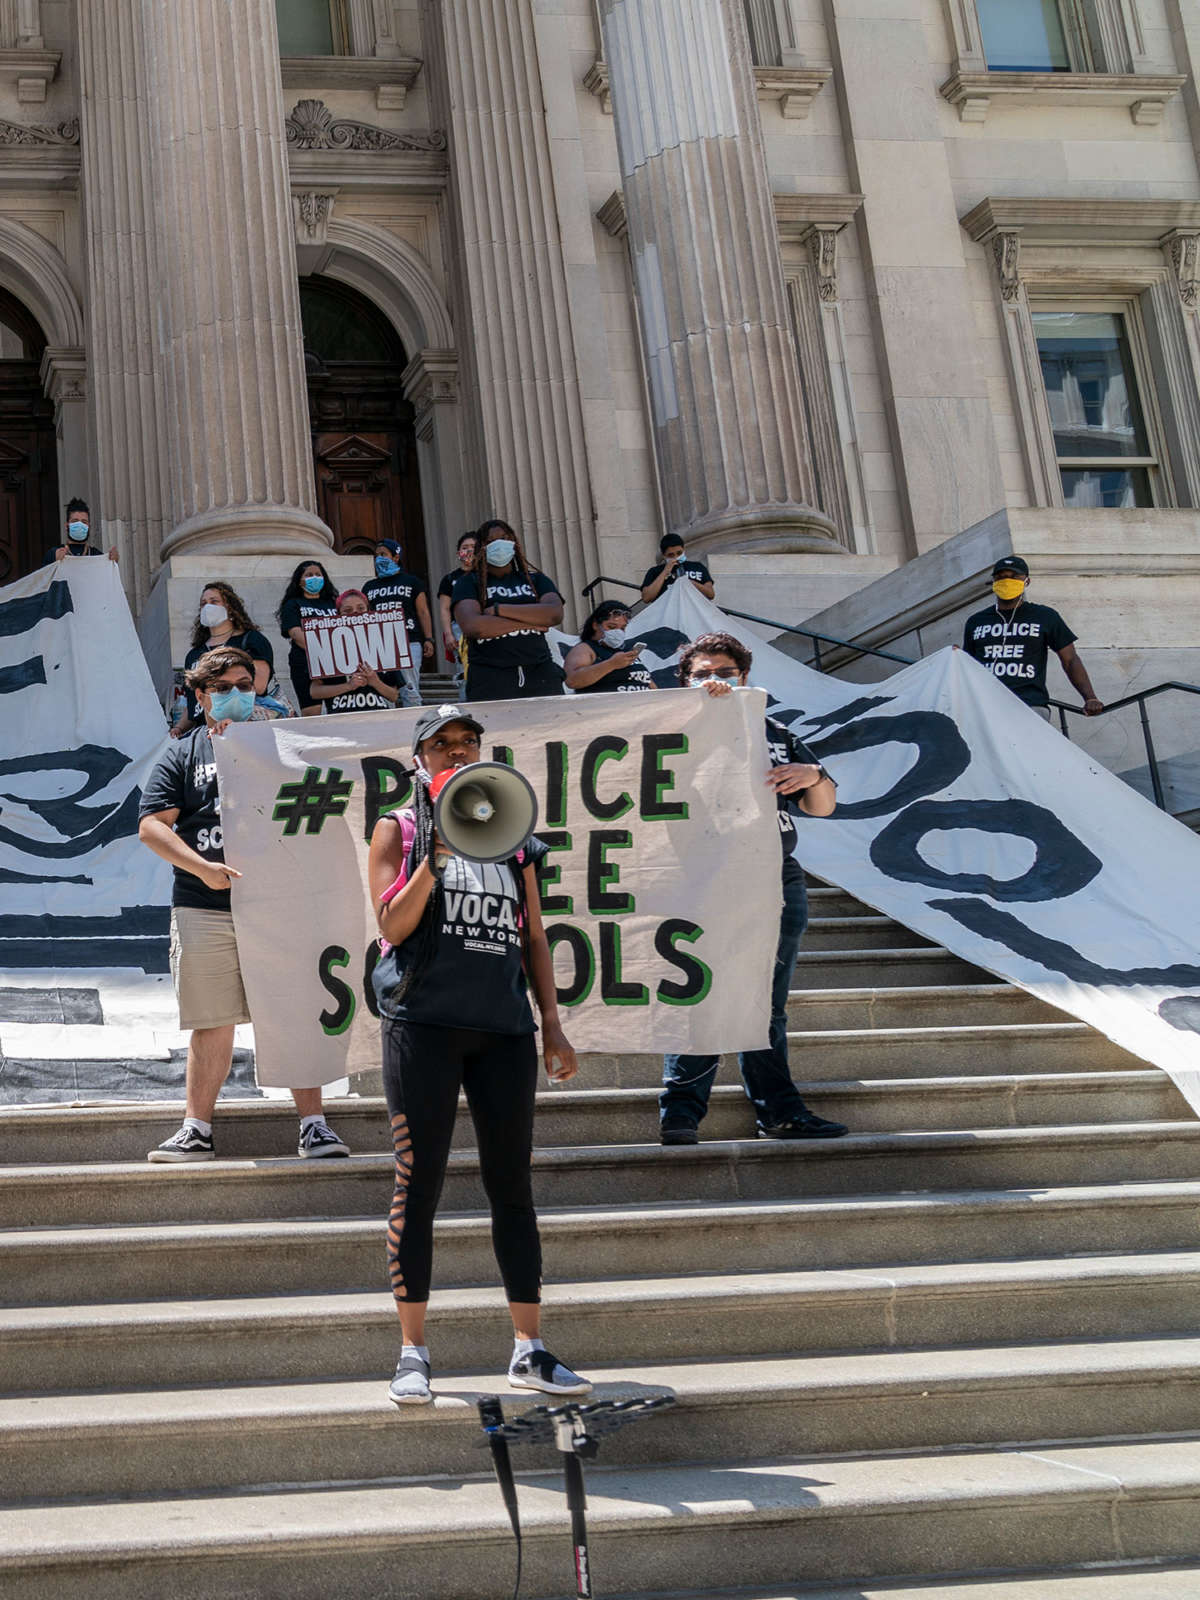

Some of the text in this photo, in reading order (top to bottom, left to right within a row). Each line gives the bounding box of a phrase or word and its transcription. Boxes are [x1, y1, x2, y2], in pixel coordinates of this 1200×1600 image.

[367, 585, 413, 601] #POLICE
[304, 611, 404, 630] #PoliceFreeSchools
[973, 622, 1040, 640] #POLICE
[305, 620, 413, 677] NOW!
[984, 645, 1025, 658] FREE
[444, 890, 519, 932] VOCA
[442, 924, 480, 937] NEW
